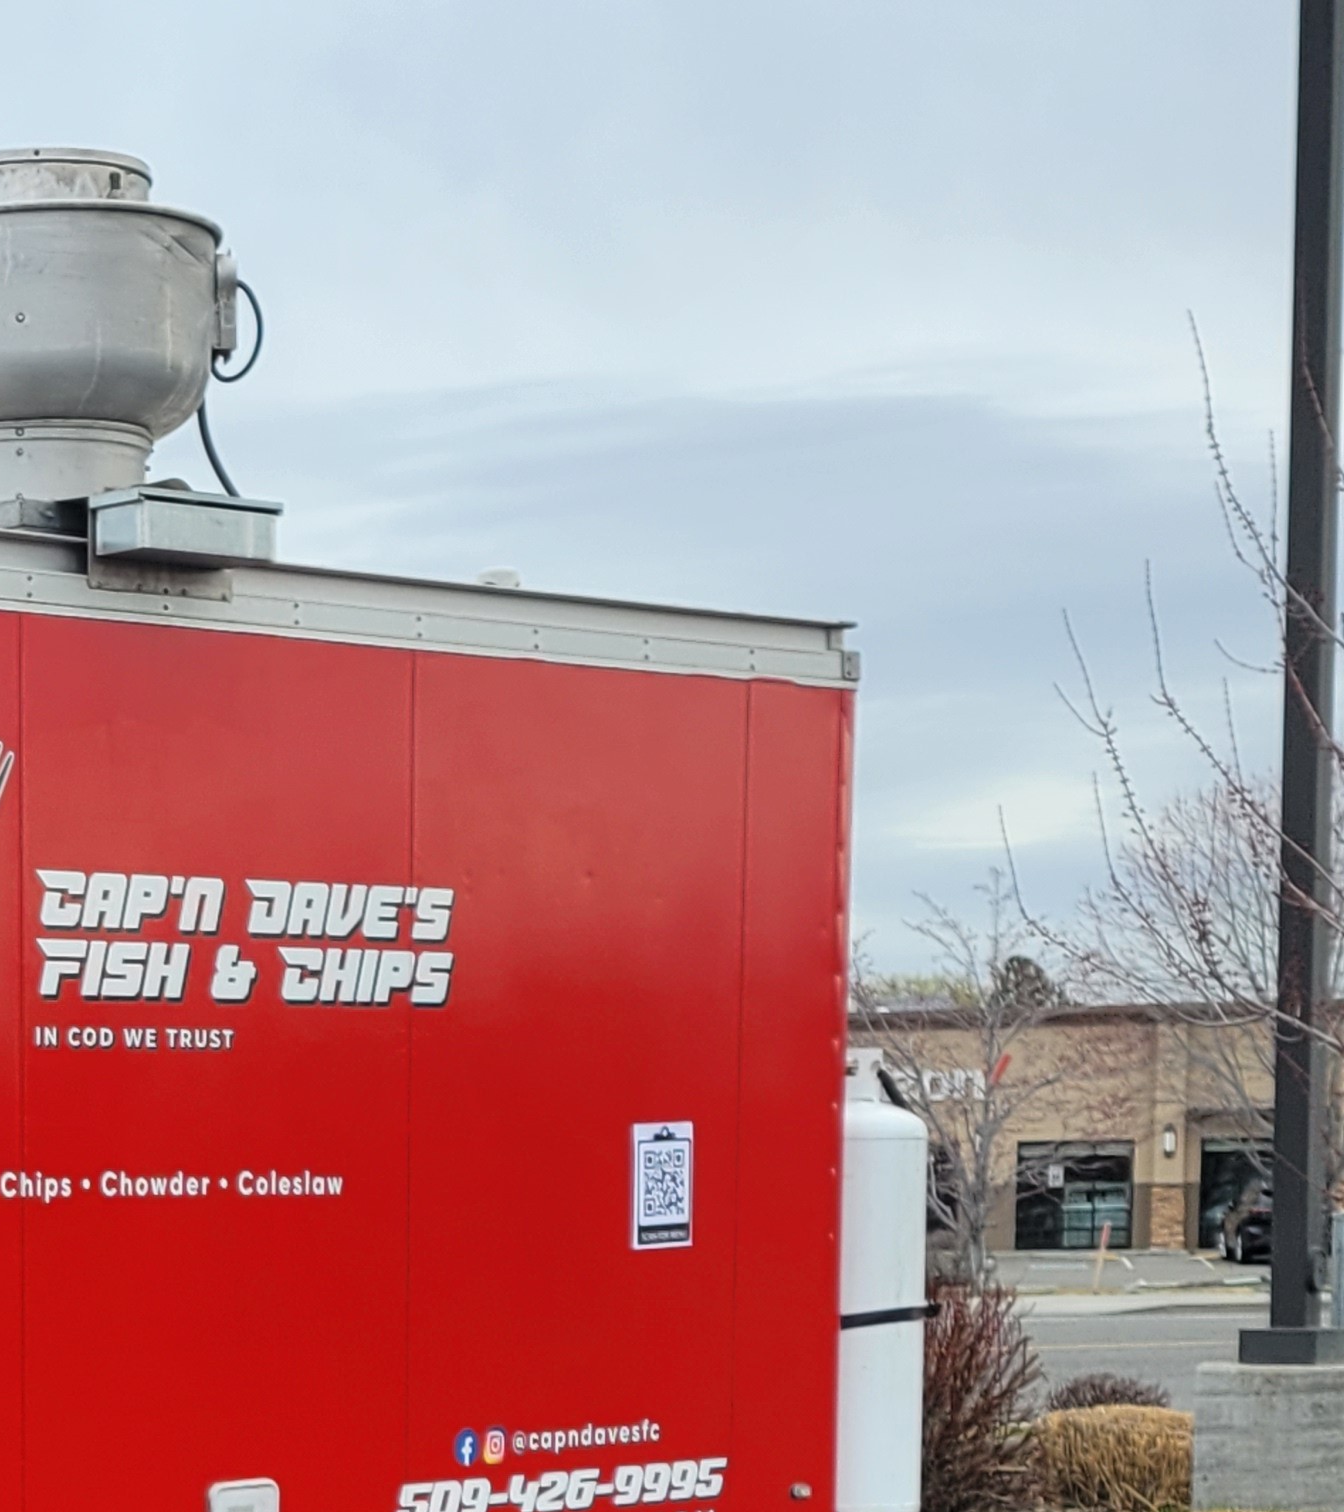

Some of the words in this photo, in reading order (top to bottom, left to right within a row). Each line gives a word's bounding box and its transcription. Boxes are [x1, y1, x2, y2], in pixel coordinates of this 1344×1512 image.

[35, 868, 224, 934] CAP'N
[245, 879, 454, 940] DAVE'S
[35, 938, 190, 998] FISH
[211, 944, 257, 1001] &
[278, 946, 454, 1005] CHIPS
[35, 1025, 58, 1048] IN
[67, 1026, 114, 1049] COD
[123, 1027, 157, 1049] WE
[167, 1027, 234, 1050] TRUST
[0, 1171, 72, 1203] Chips
[100, 1169, 211, 1198] Chowder
[238, 1169, 344, 1197] Coleslaw
[512, 1418, 660, 1455] @capndavesfc
